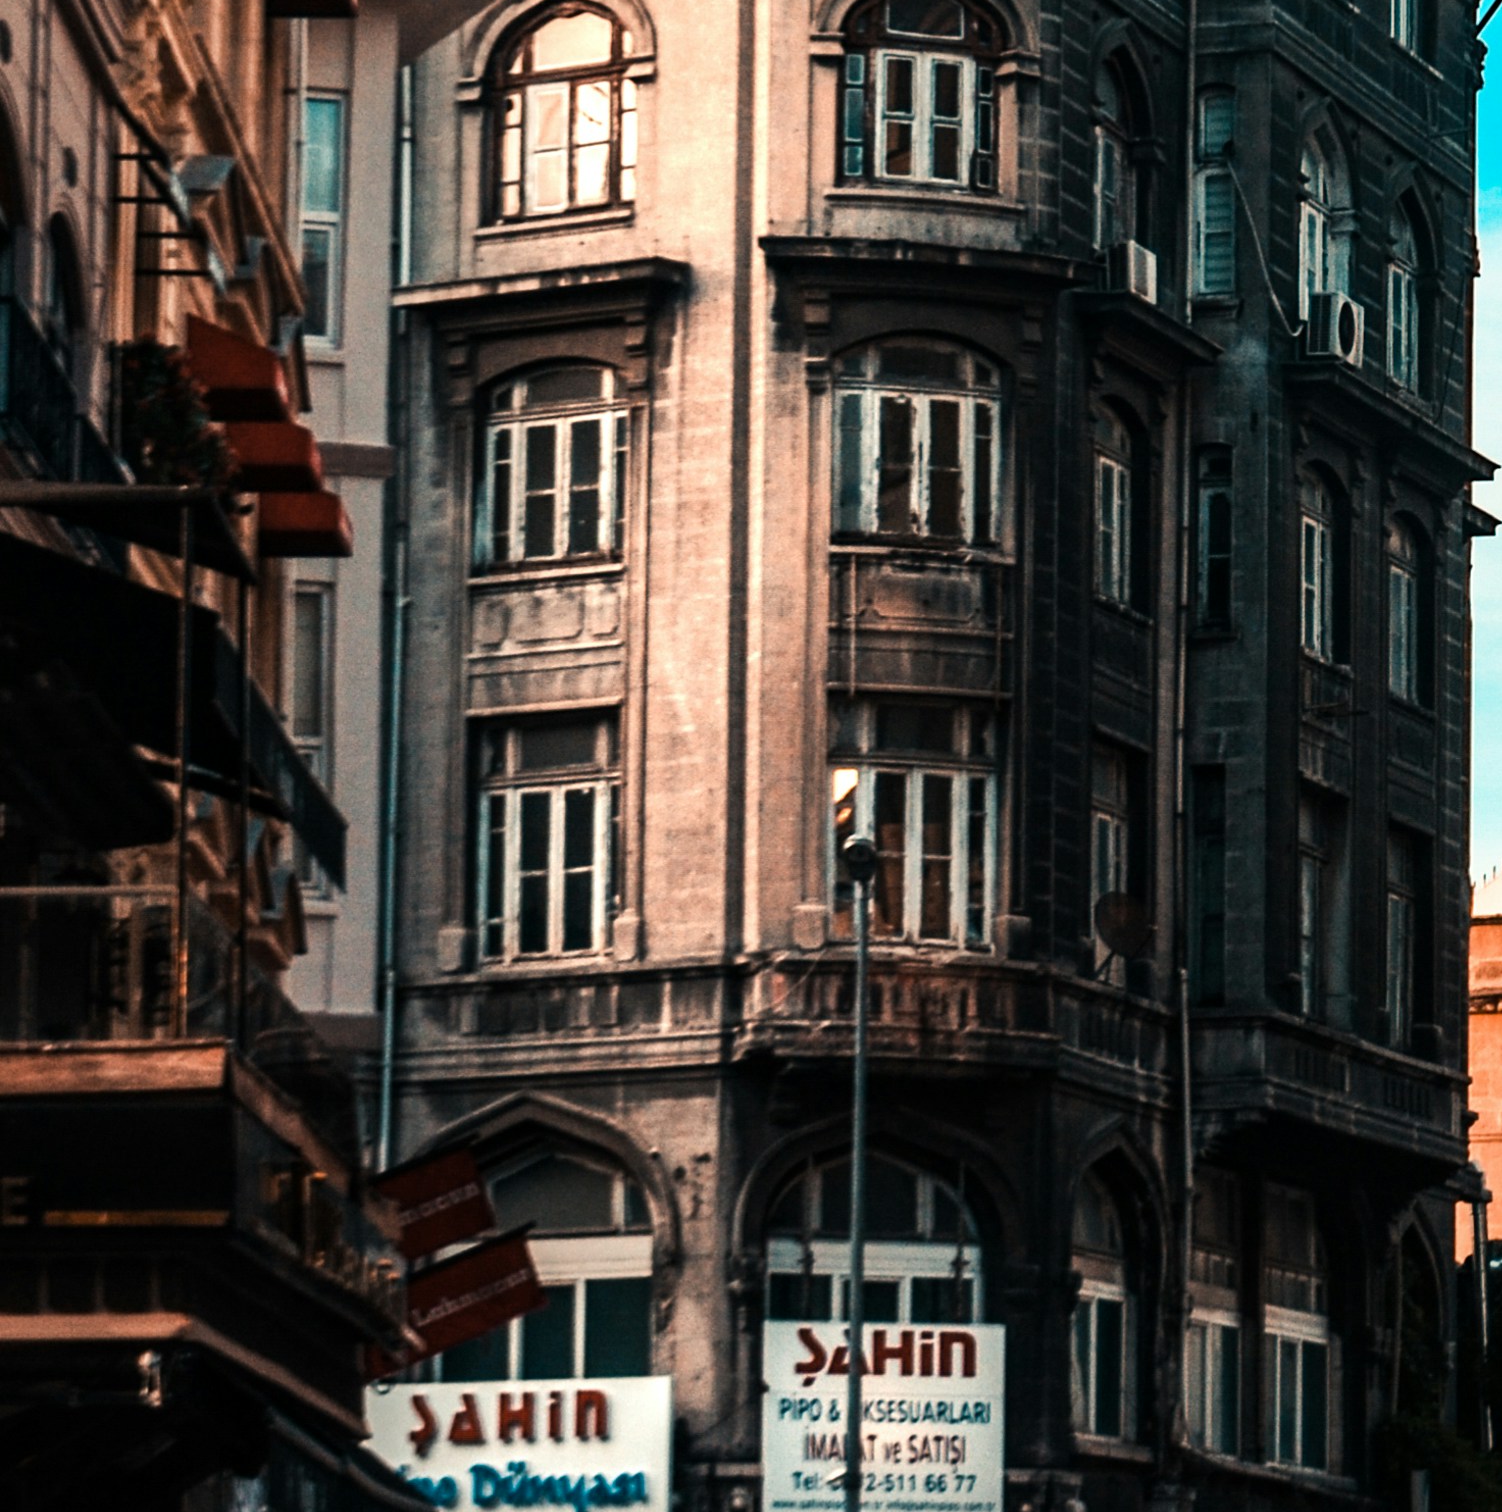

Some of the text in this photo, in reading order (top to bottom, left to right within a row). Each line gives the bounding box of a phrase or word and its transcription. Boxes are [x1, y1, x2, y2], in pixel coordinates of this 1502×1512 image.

[828, 1400, 841, 1421] &
[862, 1399, 992, 1425] KSESUARLARI
[924, 1474, 948, 1494] 66
[954, 1474, 978, 1493] 77
